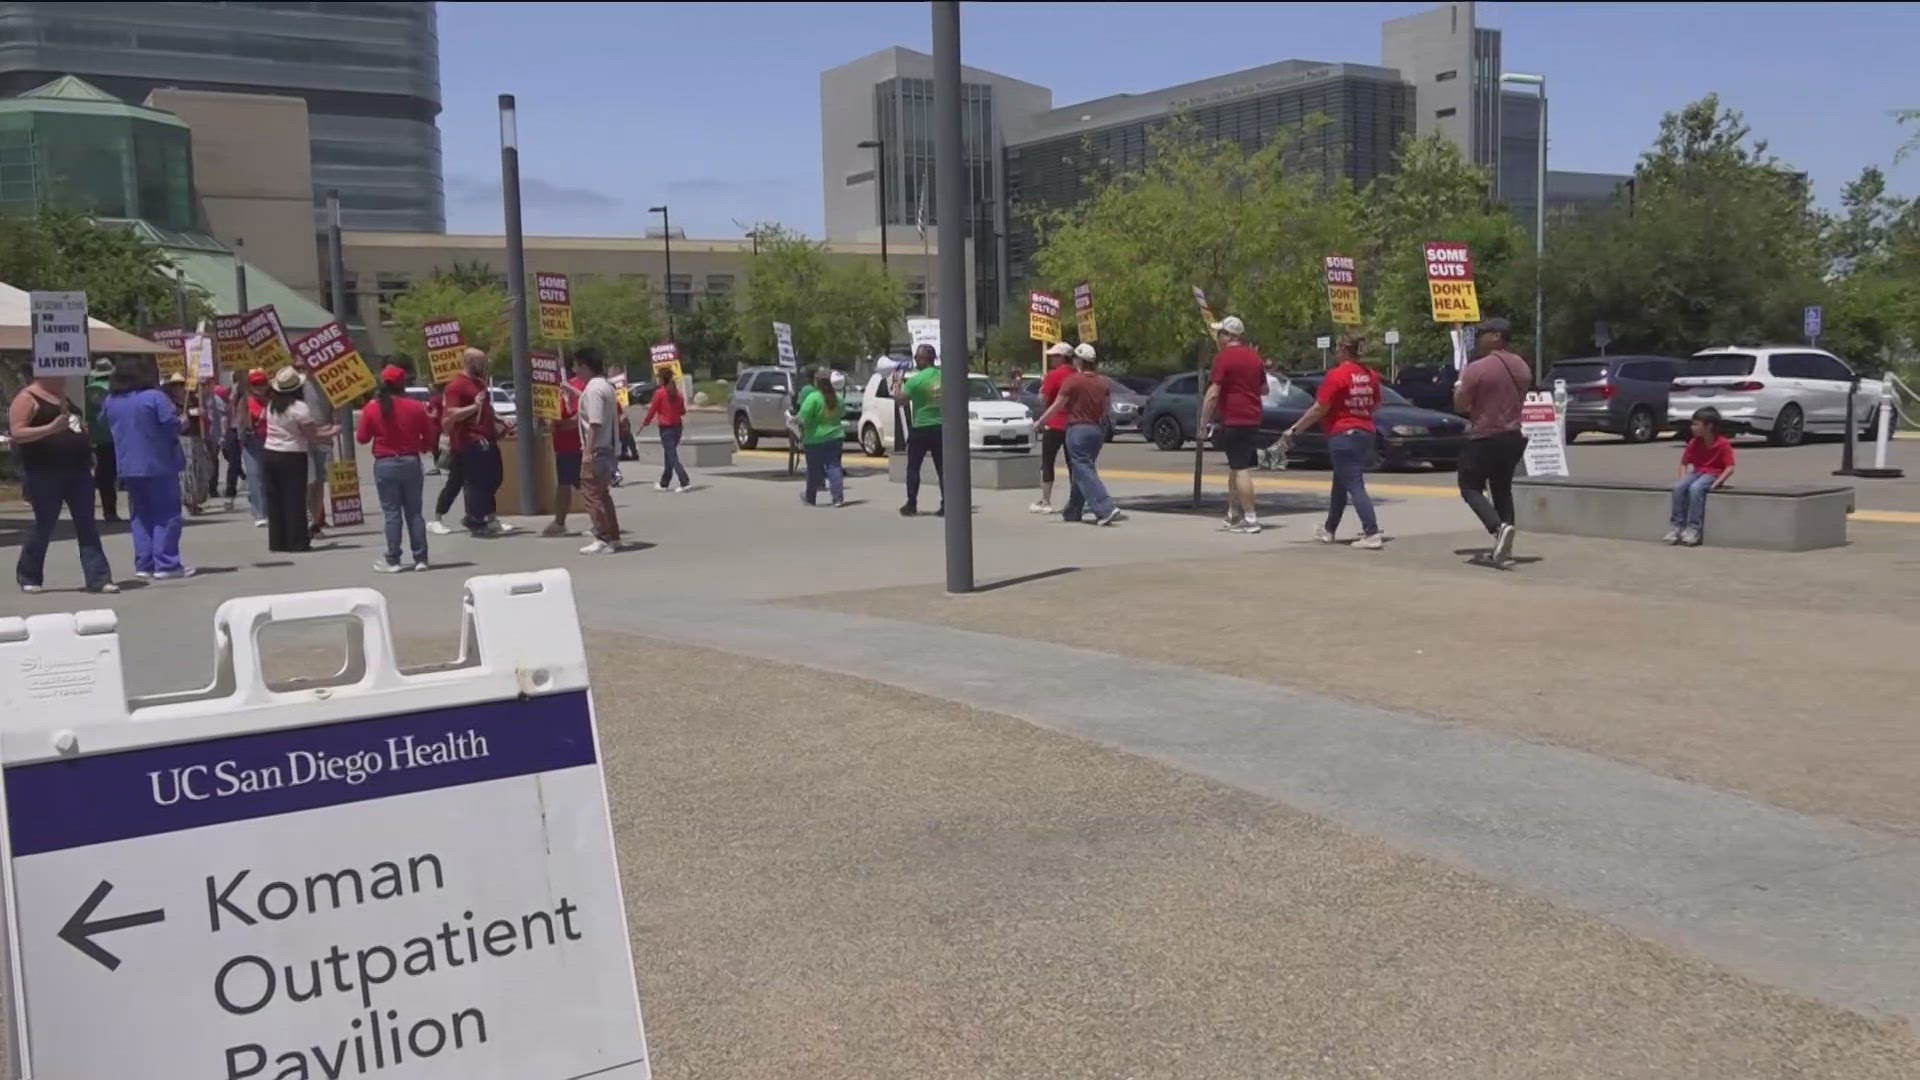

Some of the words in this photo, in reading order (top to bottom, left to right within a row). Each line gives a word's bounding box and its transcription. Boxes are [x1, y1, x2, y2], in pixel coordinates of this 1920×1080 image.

[1427, 249, 1468, 262] SOME
[1326, 257, 1354, 269] SOME
[1429, 263, 1465, 276] CUTS
[1328, 270, 1353, 282] CUTS
[538, 276, 567, 290] SOME
[1432, 284, 1472, 295] DON'T
[540, 289, 565, 301] CUTS
[1330, 288, 1357, 299] DON'T
[1332, 302, 1355, 313] HEAL
[1434, 298, 1471, 310] HEAL
[541, 306, 569, 318] DON'T
[424, 321, 460, 336] SOME
[543, 319, 569, 330] HEAL
[299, 324, 342, 355] SOME
[427, 332, 459, 348] CUTS
[55, 341, 70, 353] NO
[307, 341, 345, 368] CUTS
[39, 357, 87, 368] LAYOFFS!
[531, 357, 557, 370] SOME
[318, 355, 359, 385] DON'T
[532, 370, 556, 382] CUTS
[327, 371, 364, 397] HEAL
[147, 765, 209, 807] UC
[214, 761, 283, 797] San
[285, 750, 384, 785] Diego
[385, 729, 490, 772] Health
[205, 853, 444, 932] Koman
[214, 897, 582, 1016] Outpatient
[224, 1007, 488, 1080] Pavilion
